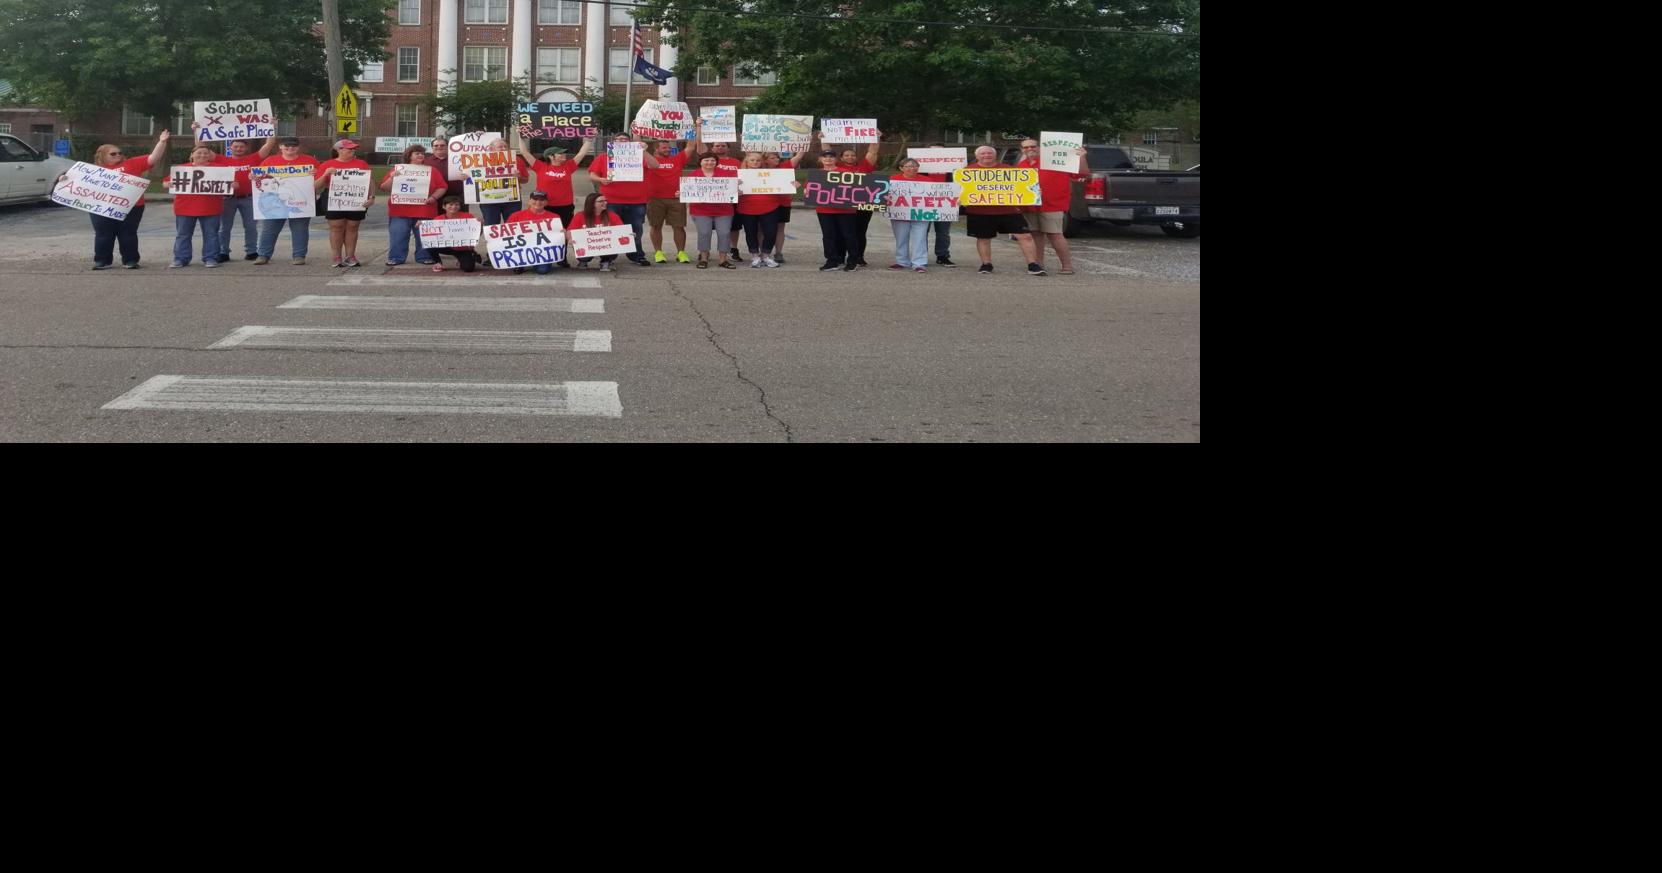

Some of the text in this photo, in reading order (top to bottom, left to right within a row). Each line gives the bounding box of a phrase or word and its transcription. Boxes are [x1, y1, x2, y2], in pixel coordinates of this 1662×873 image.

[205, 101, 258, 114] School
[518, 102, 593, 113] WE NEED
[236, 114, 269, 124] WAS
[520, 113, 592, 127] a Place
[660, 111, 683, 120] YOU
[199, 124, 274, 140] A Safe Place
[463, 131, 482, 141] MY
[544, 126, 595, 138] TABLE
[1042, 140, 1080, 150] RESPECT
[461, 150, 516, 169] DENIAL
[471, 164, 514, 177] IS NOT
[961, 169, 1030, 182] STUDENTS
[172, 170, 232, 193] #RESPECT
[826, 171, 867, 185] GOT
[400, 183, 416, 193] BE
[886, 194, 959, 208] SAFETY
[968, 193, 1024, 204] SAFETY
[489, 217, 555, 239] SAFETY
[502, 232, 551, 249] IS A
[492, 244, 566, 269] PRIORITY
